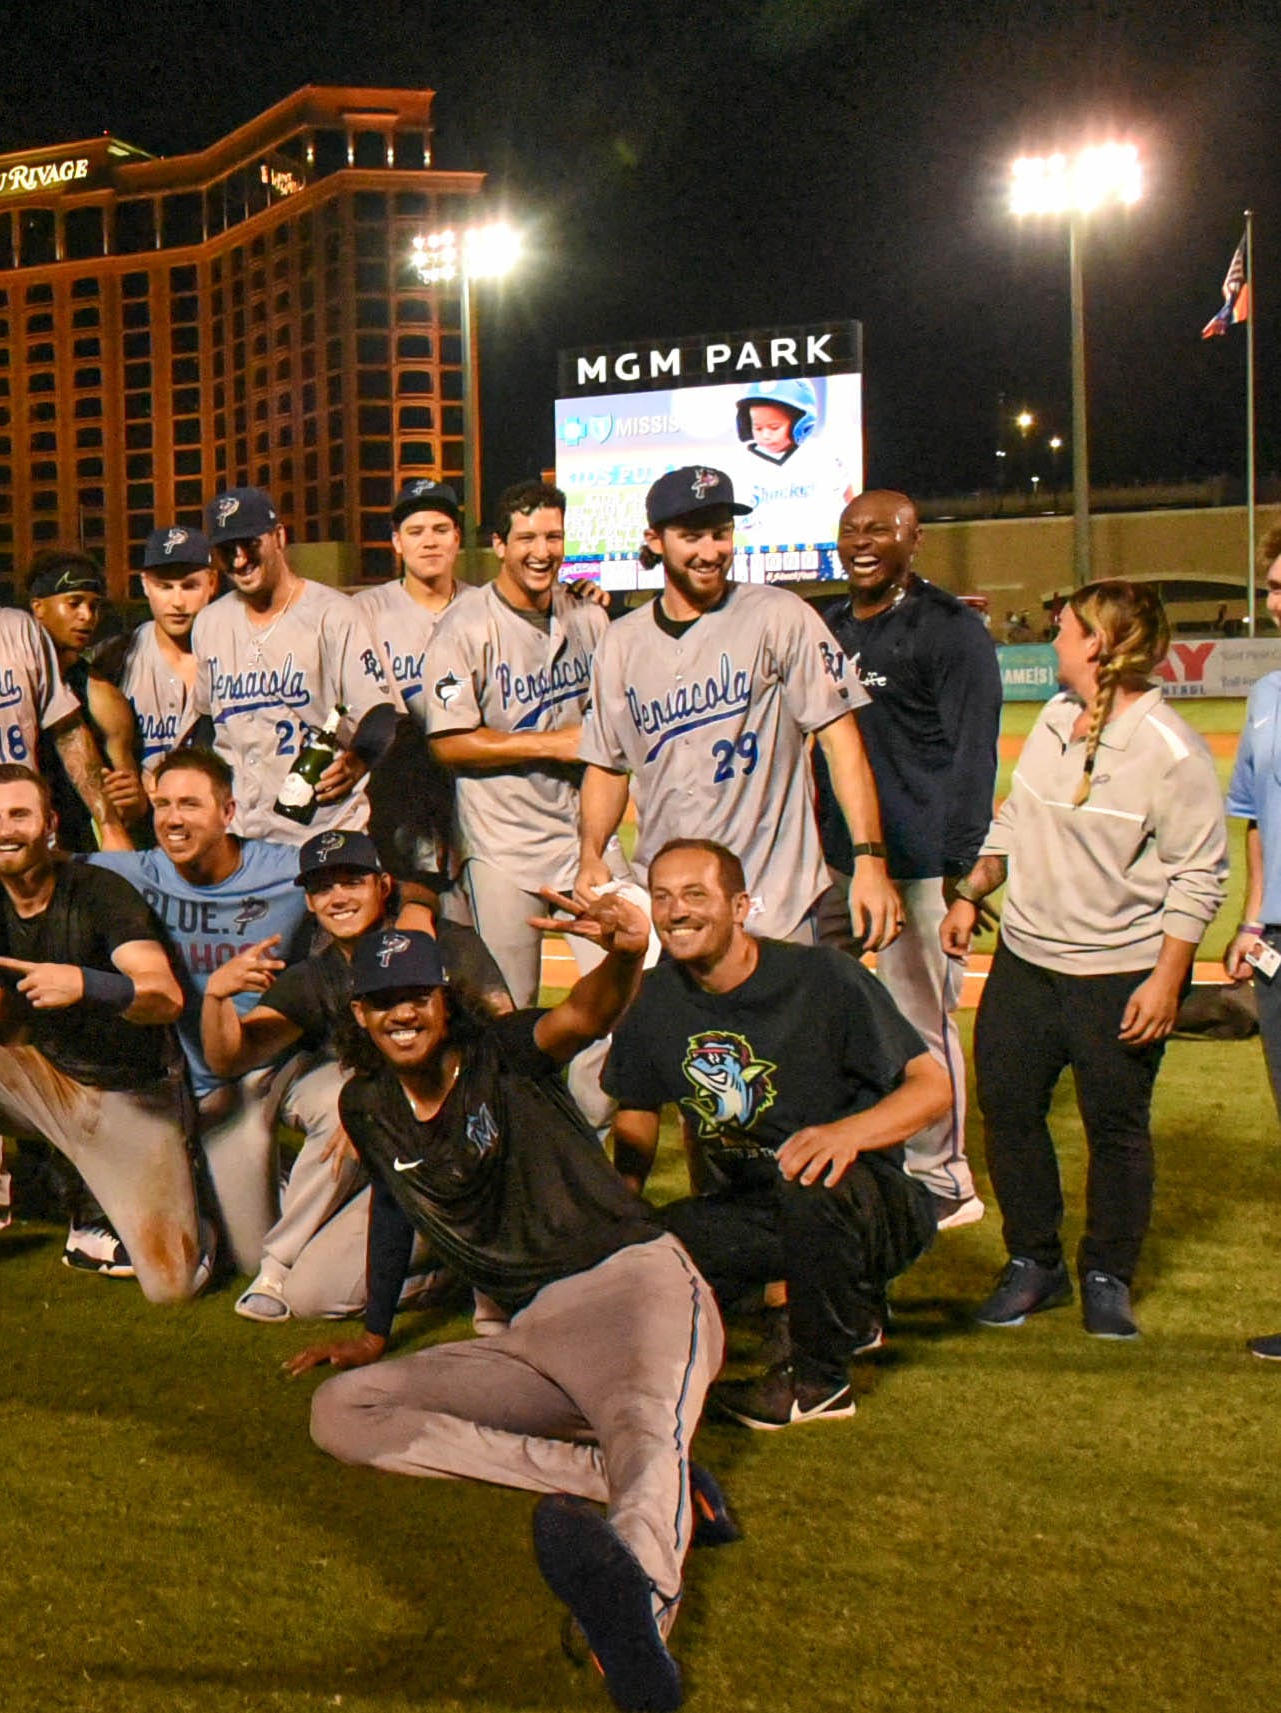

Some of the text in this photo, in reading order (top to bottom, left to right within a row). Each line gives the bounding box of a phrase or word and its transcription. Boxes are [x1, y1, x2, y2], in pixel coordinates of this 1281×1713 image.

[8, 159, 89, 190] RIVAGE
[577, 334, 832, 385] MGM PARK
[496, 654, 593, 710] Pensacol
[625, 653, 751, 737] Pensacola
[712, 731, 758, 783] 29
